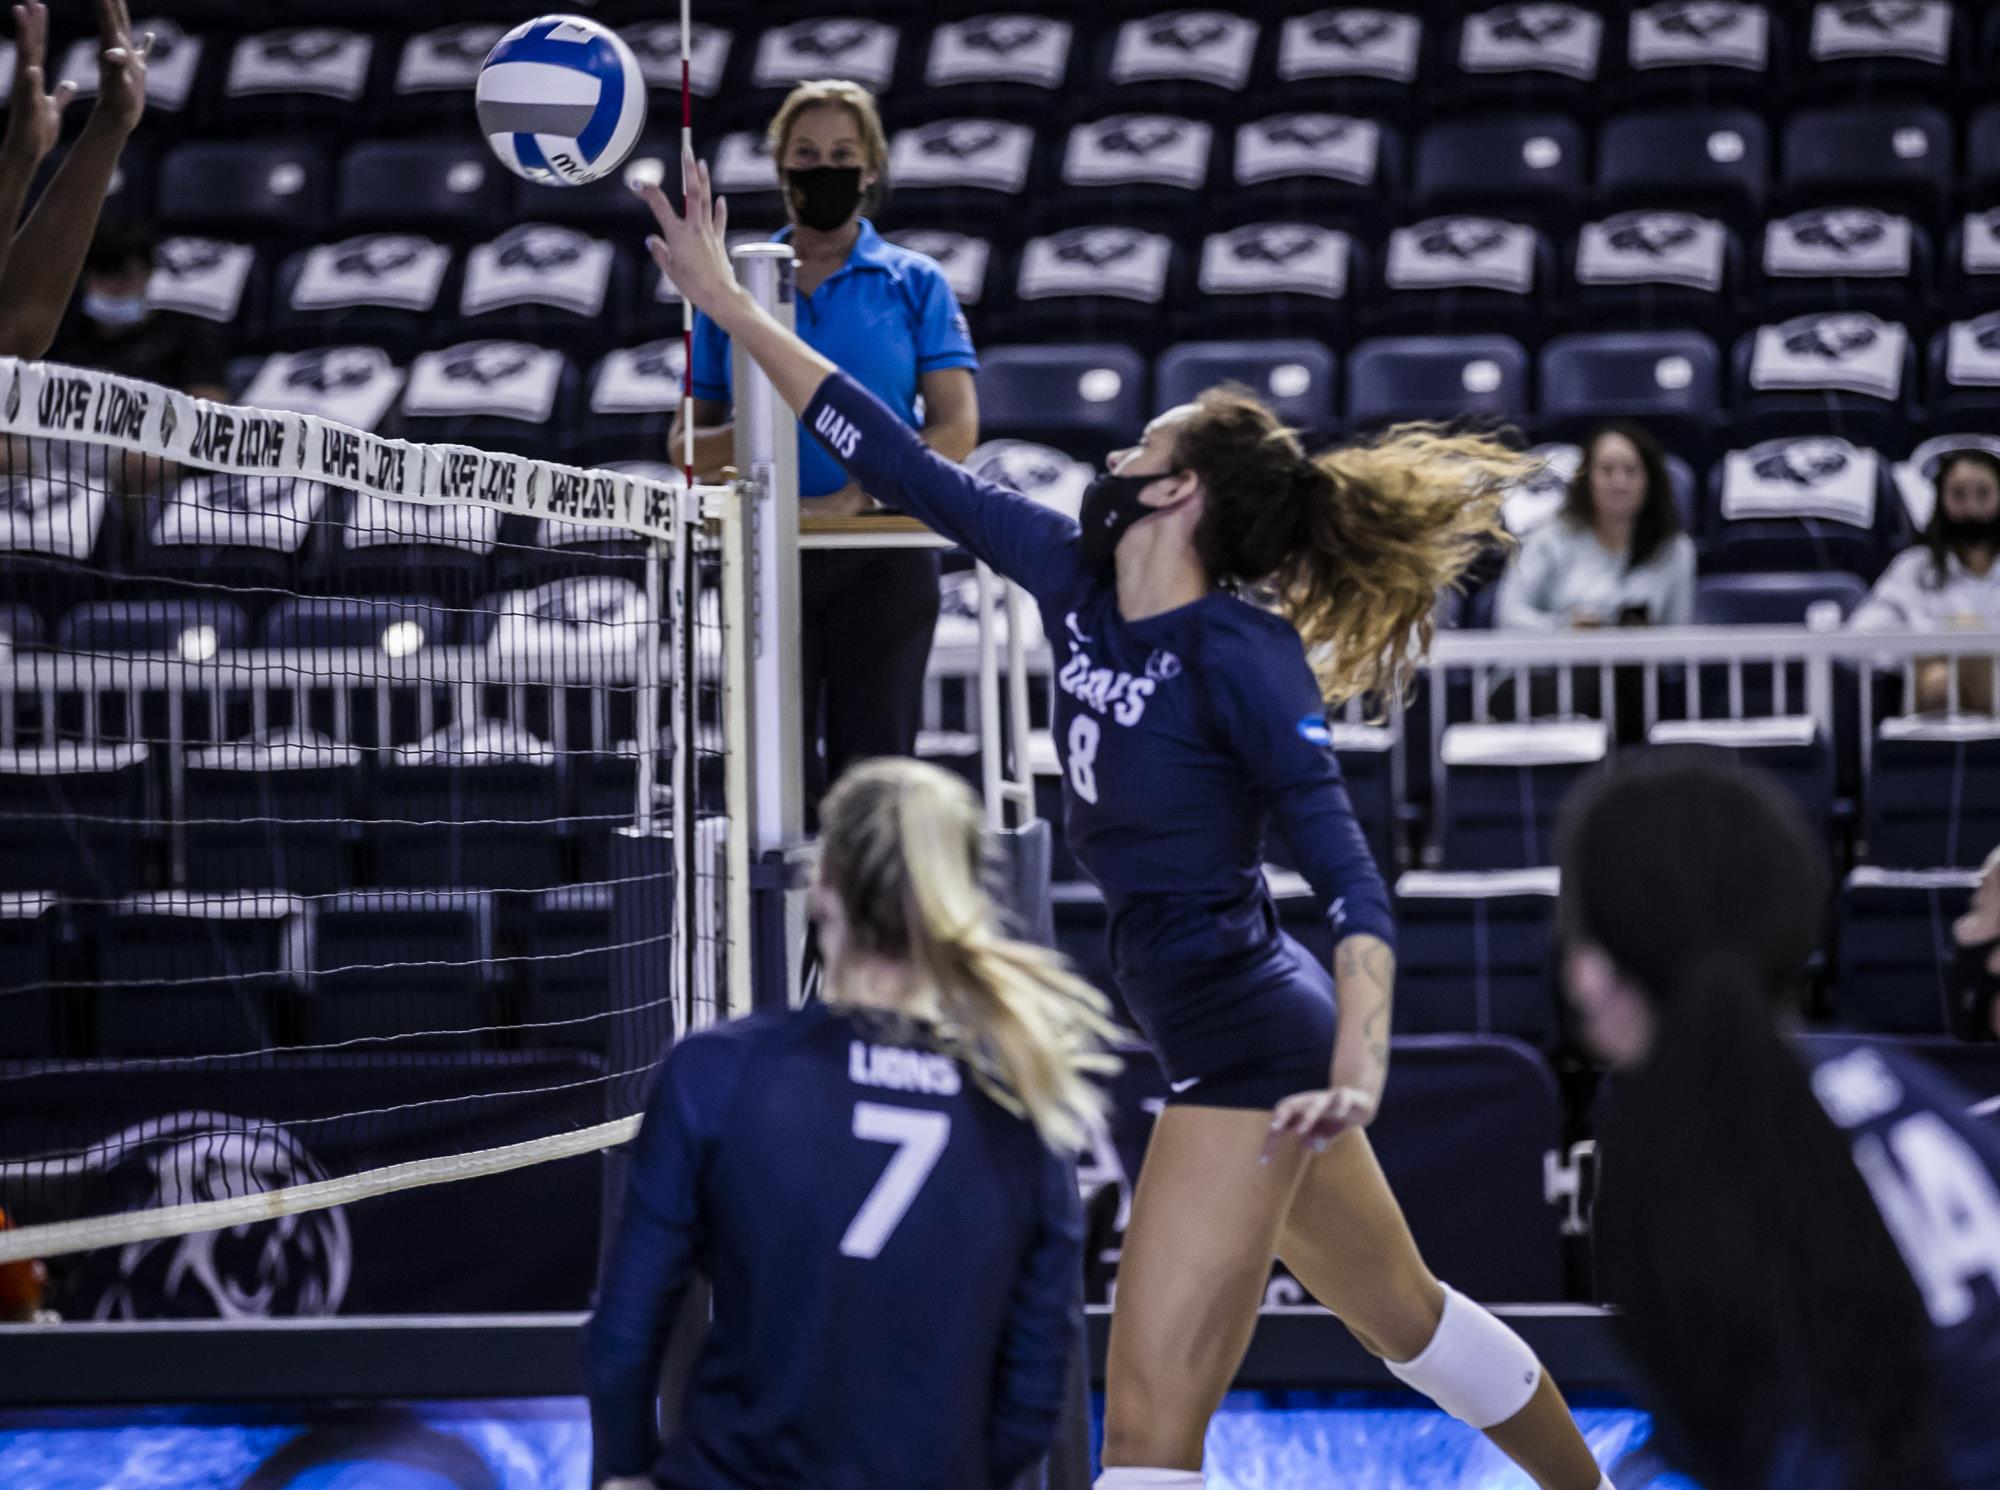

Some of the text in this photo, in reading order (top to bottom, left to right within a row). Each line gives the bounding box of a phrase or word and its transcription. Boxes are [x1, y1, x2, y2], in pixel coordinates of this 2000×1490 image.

[814, 403, 863, 459] UAFS
[1067, 713, 1101, 806] 8
[838, 1100, 952, 1260] 7
